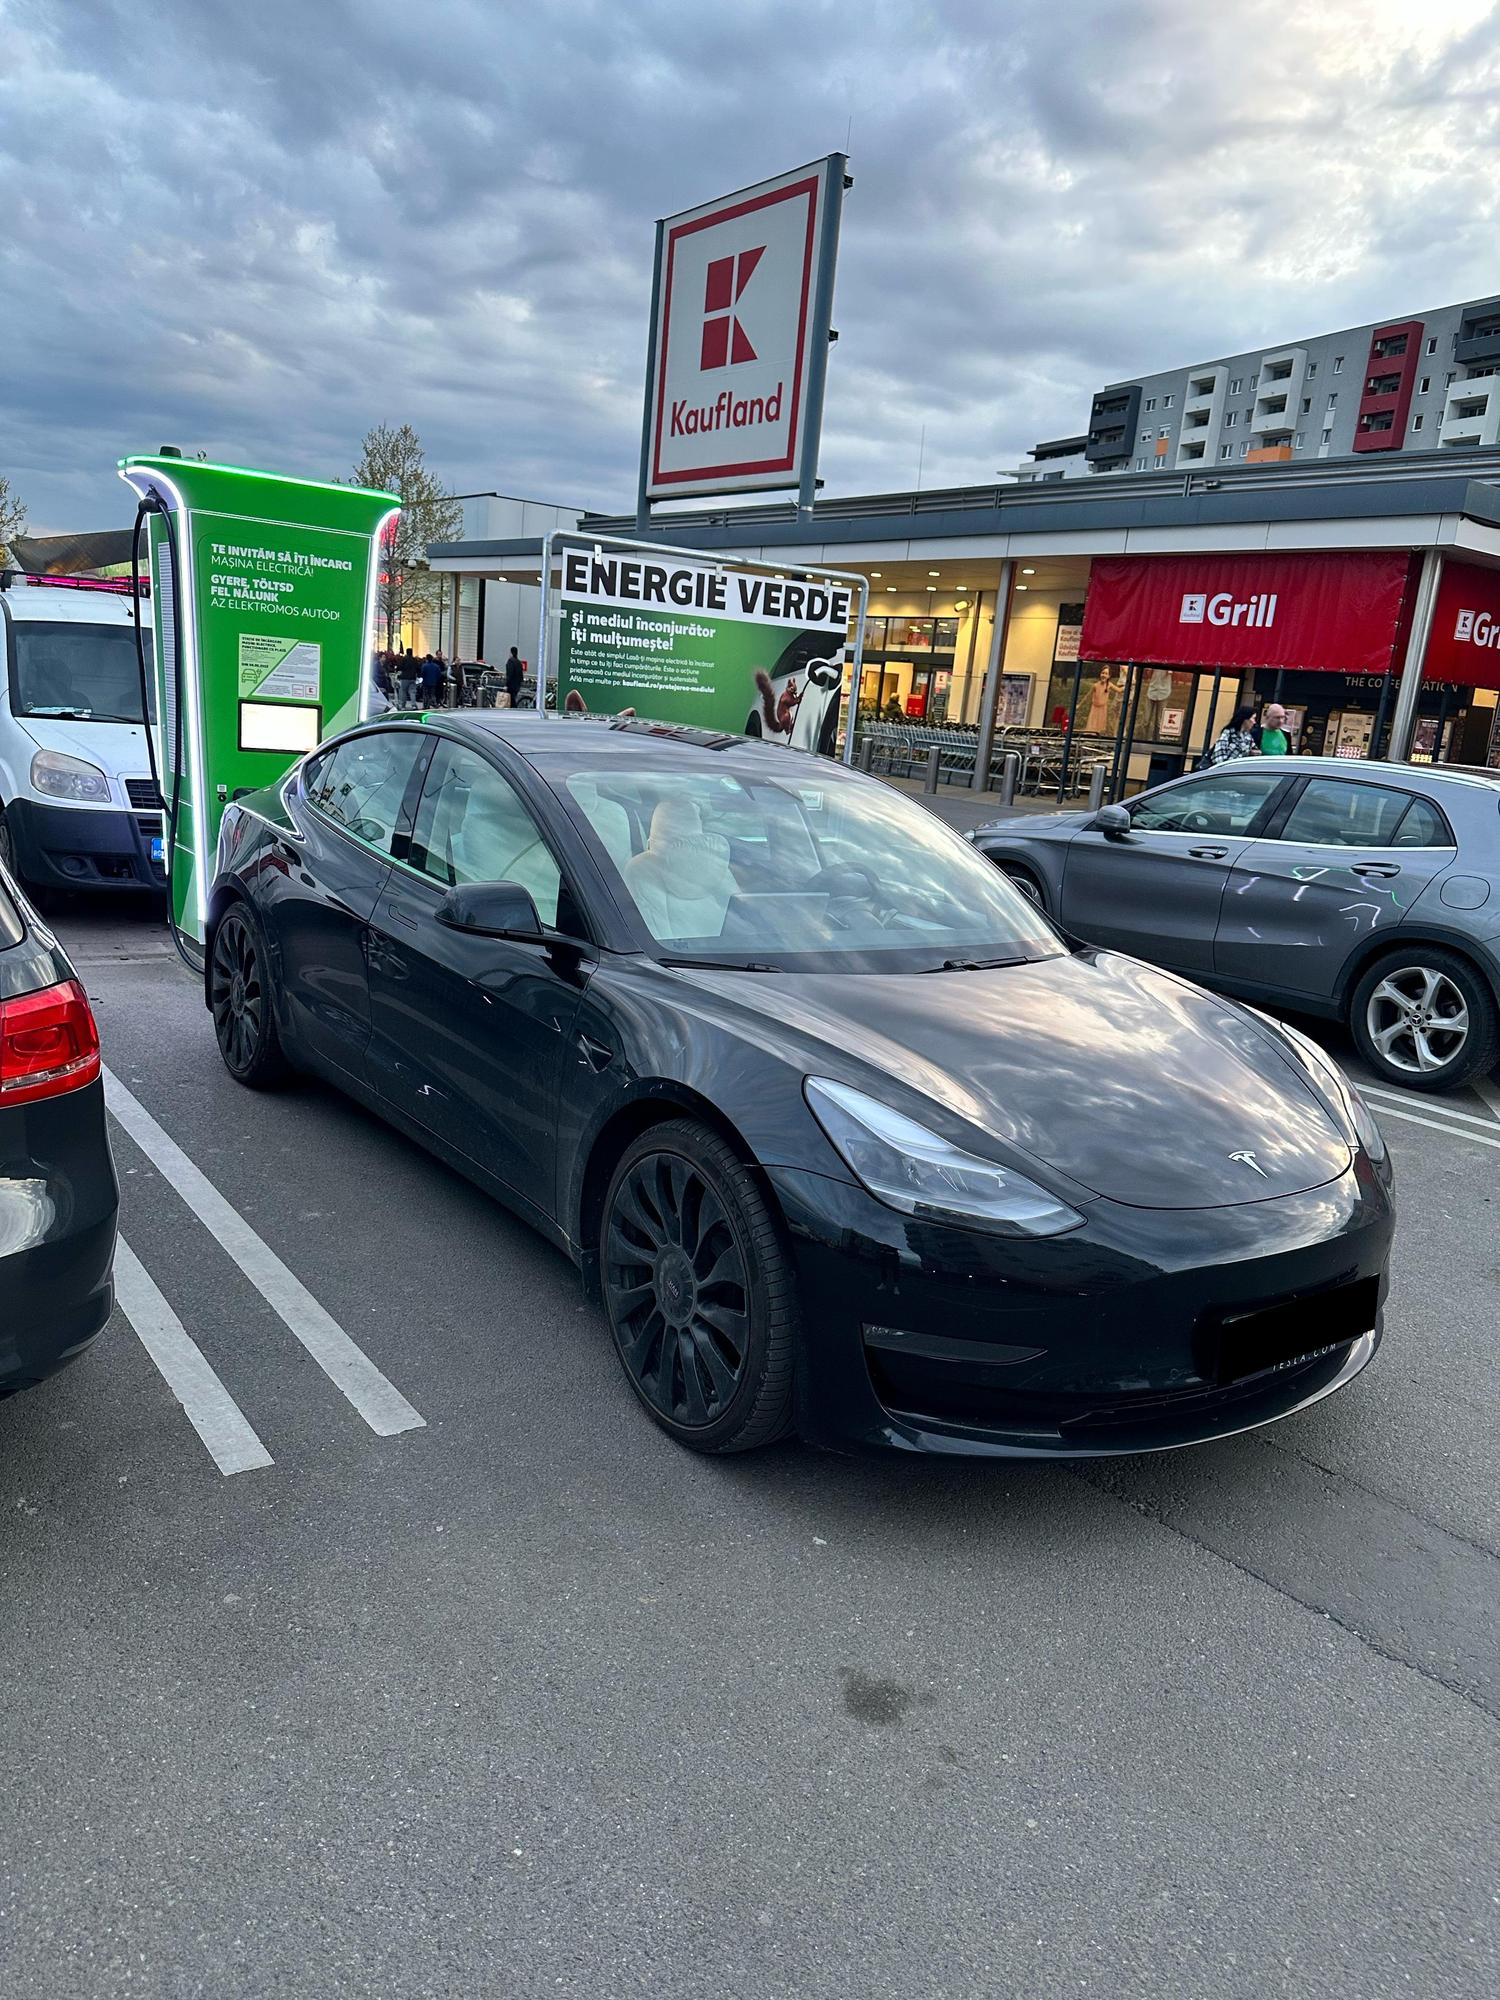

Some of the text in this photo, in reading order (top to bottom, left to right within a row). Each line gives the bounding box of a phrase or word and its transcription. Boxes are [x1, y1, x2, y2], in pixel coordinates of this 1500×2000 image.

[670, 382, 783, 437] Kaufland
[212, 544, 225, 554] TE
[228, 547, 276, 561] INVITĂM
[278, 551, 291, 563] SĂ
[310, 554, 352, 571] ÎNCARCI
[212, 556, 314, 577] MAȘINA ELECTRICĂ!
[211, 574, 294, 593] GYERE, TÖLTSD
[211, 586, 279, 602] FEL NÁLUNK
[566, 554, 849, 625] ENERGIE VERDE
[211, 598, 340, 621] AZ ELEKTROMOS AUTÓD!
[1208, 593, 1277, 627] Grill
[572, 610, 716, 638] și mediul înconjurător
[1474, 612, 1500, 649] Gr
[571, 627, 674, 652] îți mulțumește!
[571, 648, 583, 656] Este
[577, 658, 590, 666] timp
[1345, 676, 1365, 687] THE
